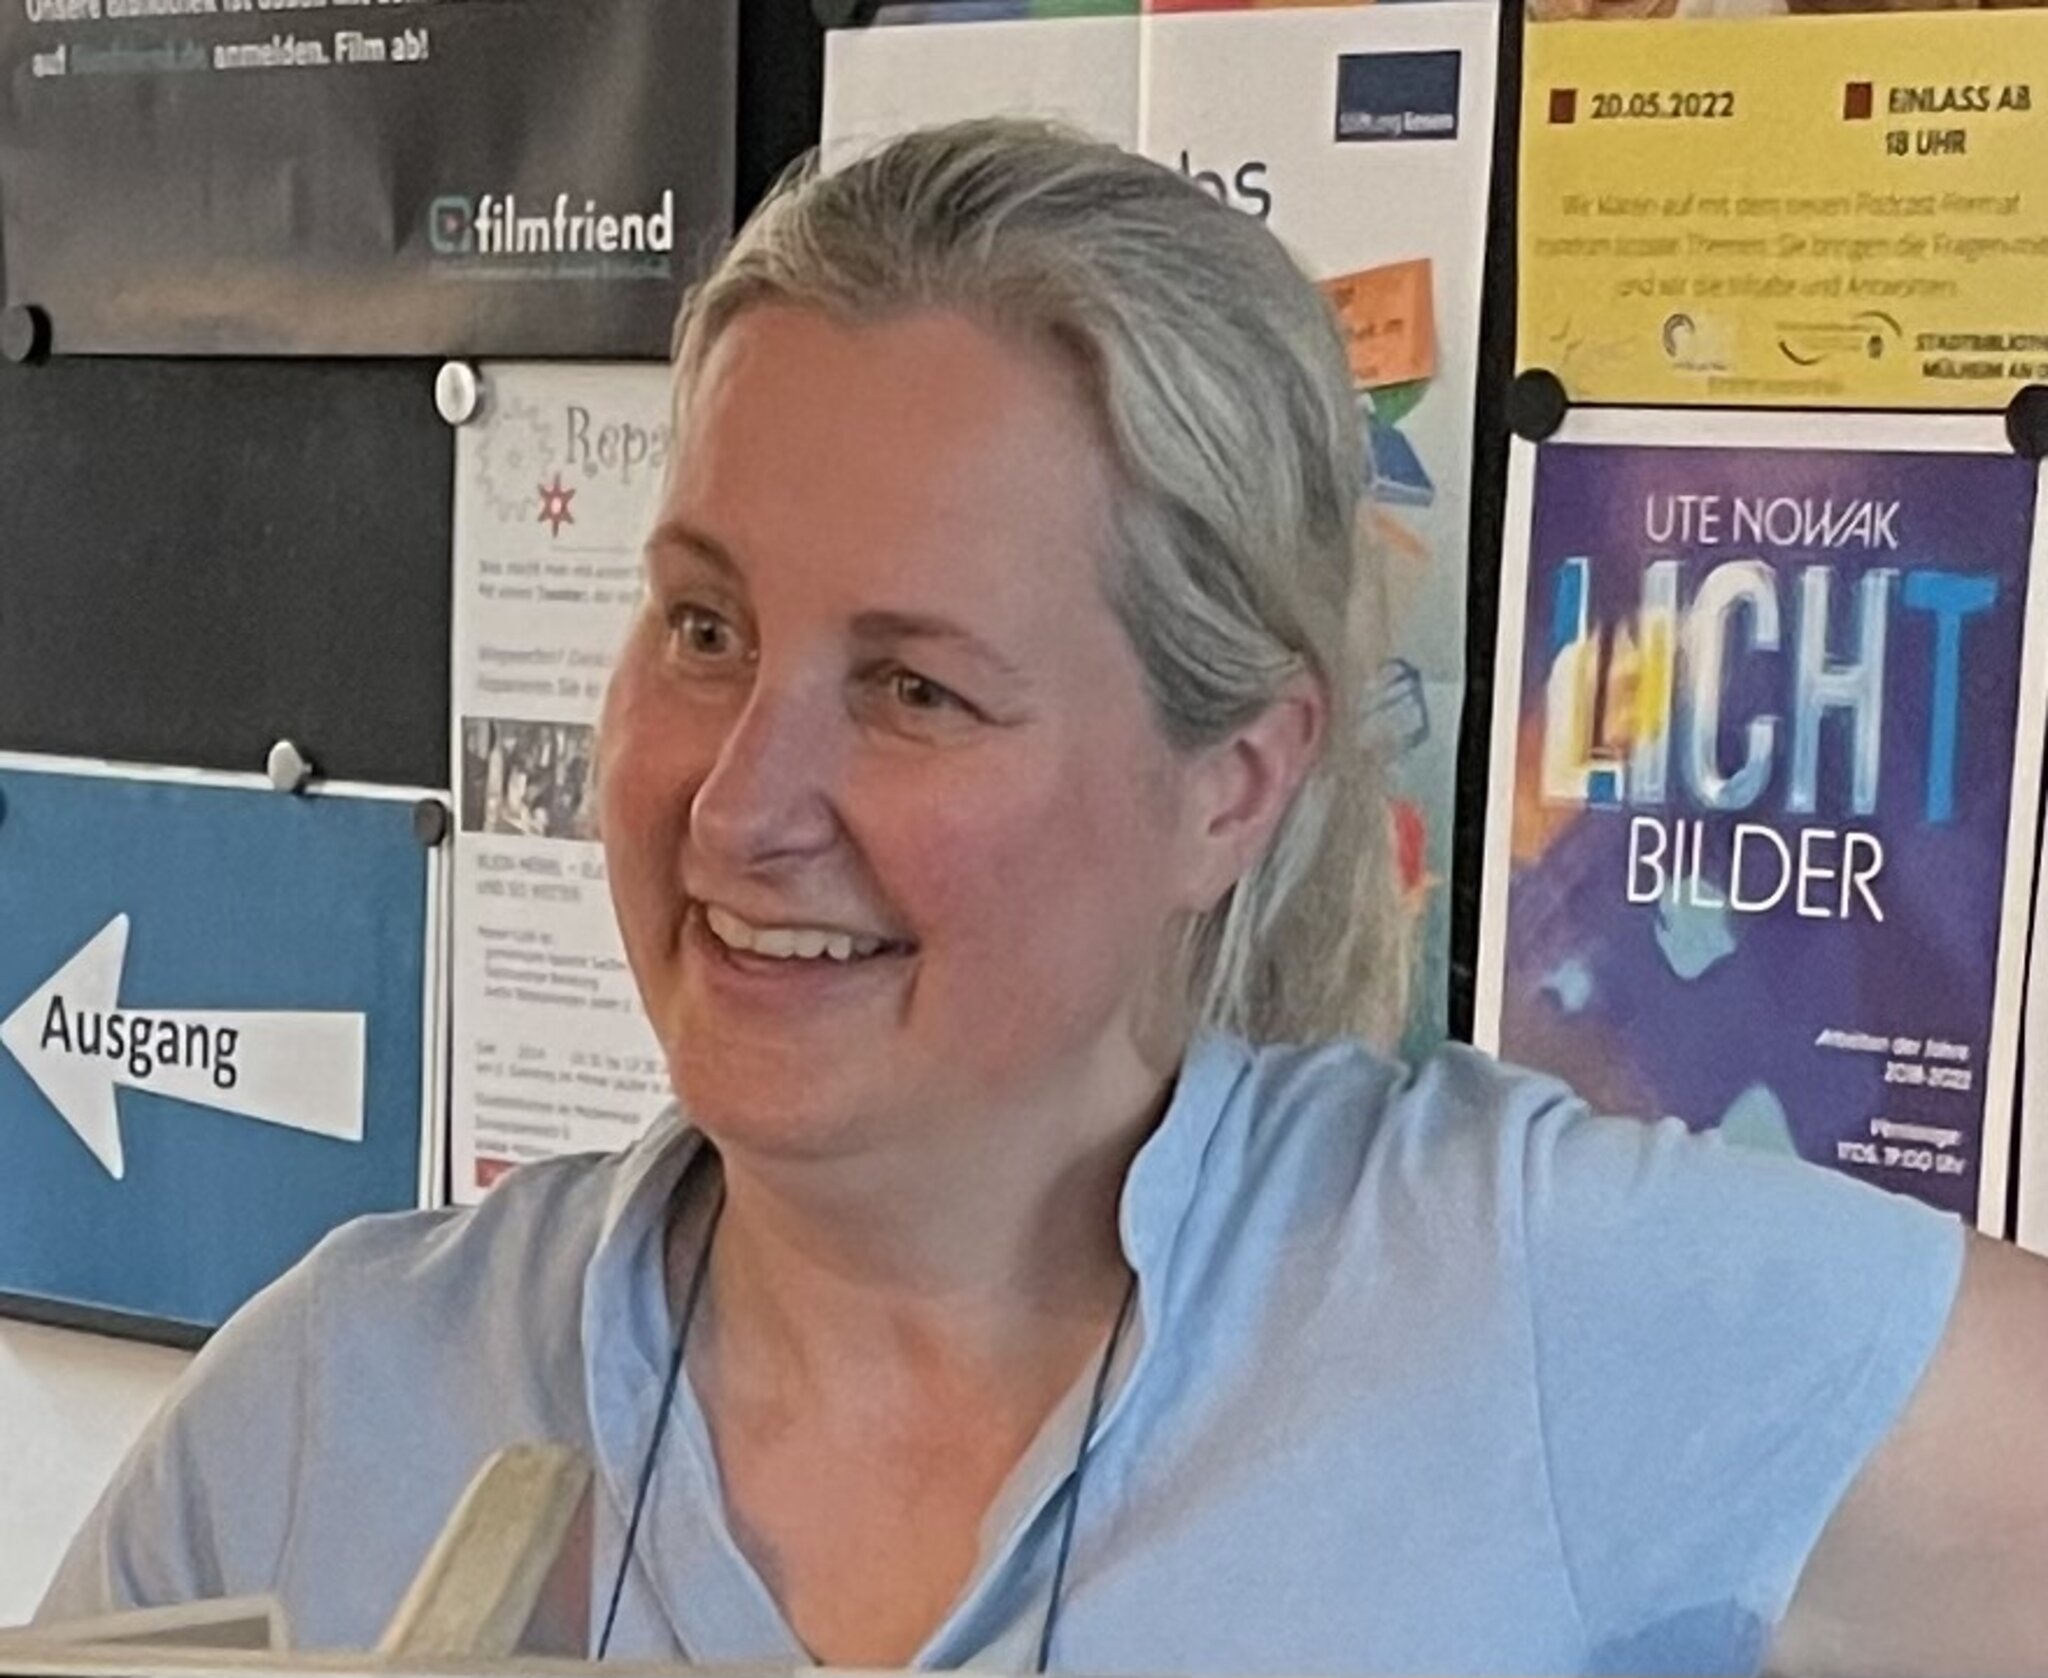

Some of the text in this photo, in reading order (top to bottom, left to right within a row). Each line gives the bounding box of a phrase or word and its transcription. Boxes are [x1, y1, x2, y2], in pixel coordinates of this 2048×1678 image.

[334, 31, 386, 63] Film
[391, 28, 430, 61] ab!
[1591, 84, 2031, 120] 20.05.2022 EINLASS AB
[1916, 129, 1967, 155] UHR
[474, 189, 674, 253] filmfriend
[1646, 494, 1901, 550] UTE NOWAK
[1627, 815, 1885, 923] BILDER
[40, 995, 239, 1088] Ausgang
